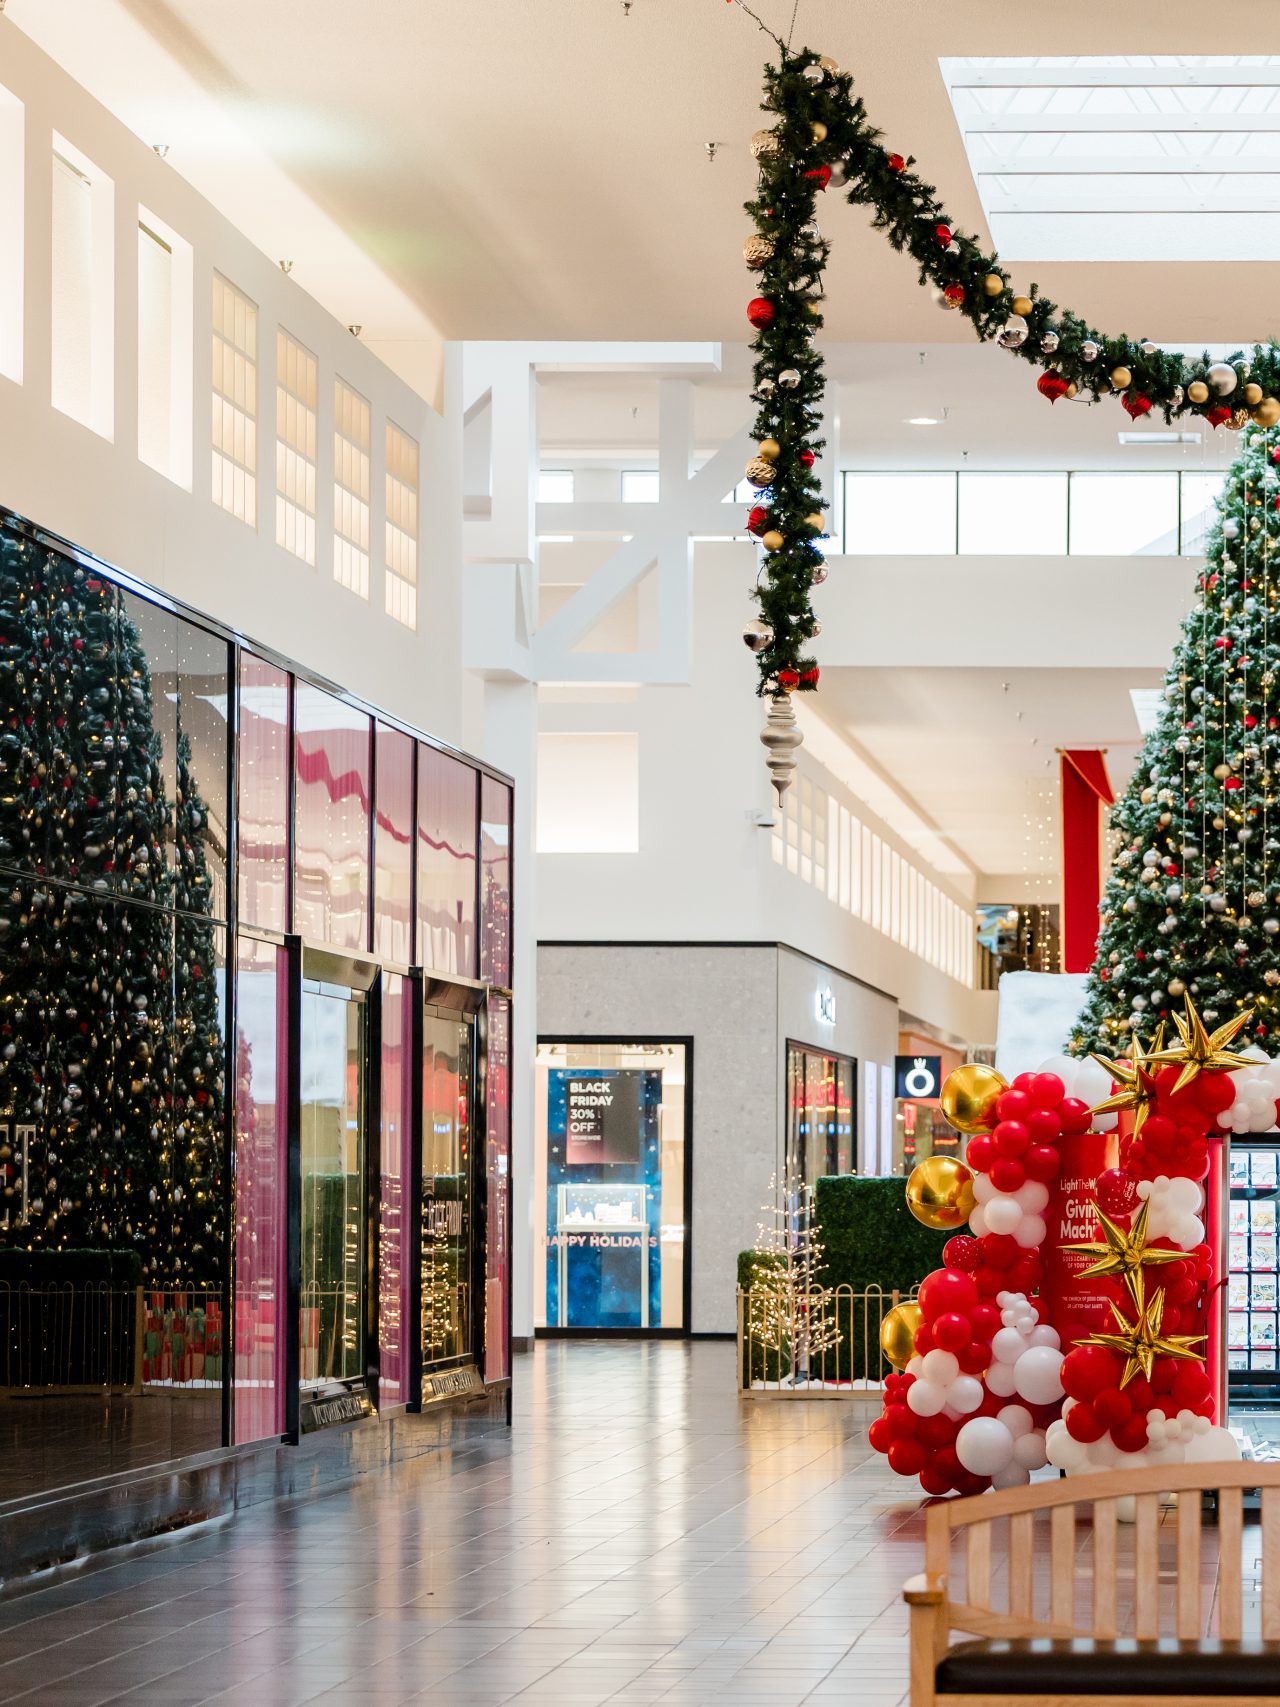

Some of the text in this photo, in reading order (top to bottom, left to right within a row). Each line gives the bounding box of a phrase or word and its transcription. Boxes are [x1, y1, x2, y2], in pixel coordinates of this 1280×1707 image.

[570, 1083, 611, 1093] BLACK
[570, 1096, 613, 1106] FRIDAY
[570, 1109, 595, 1119] 30%
[1060, 1177, 1097, 1194] LightTheW
[1066, 1199, 1098, 1219] Givin
[1060, 1219, 1097, 1239] Machi
